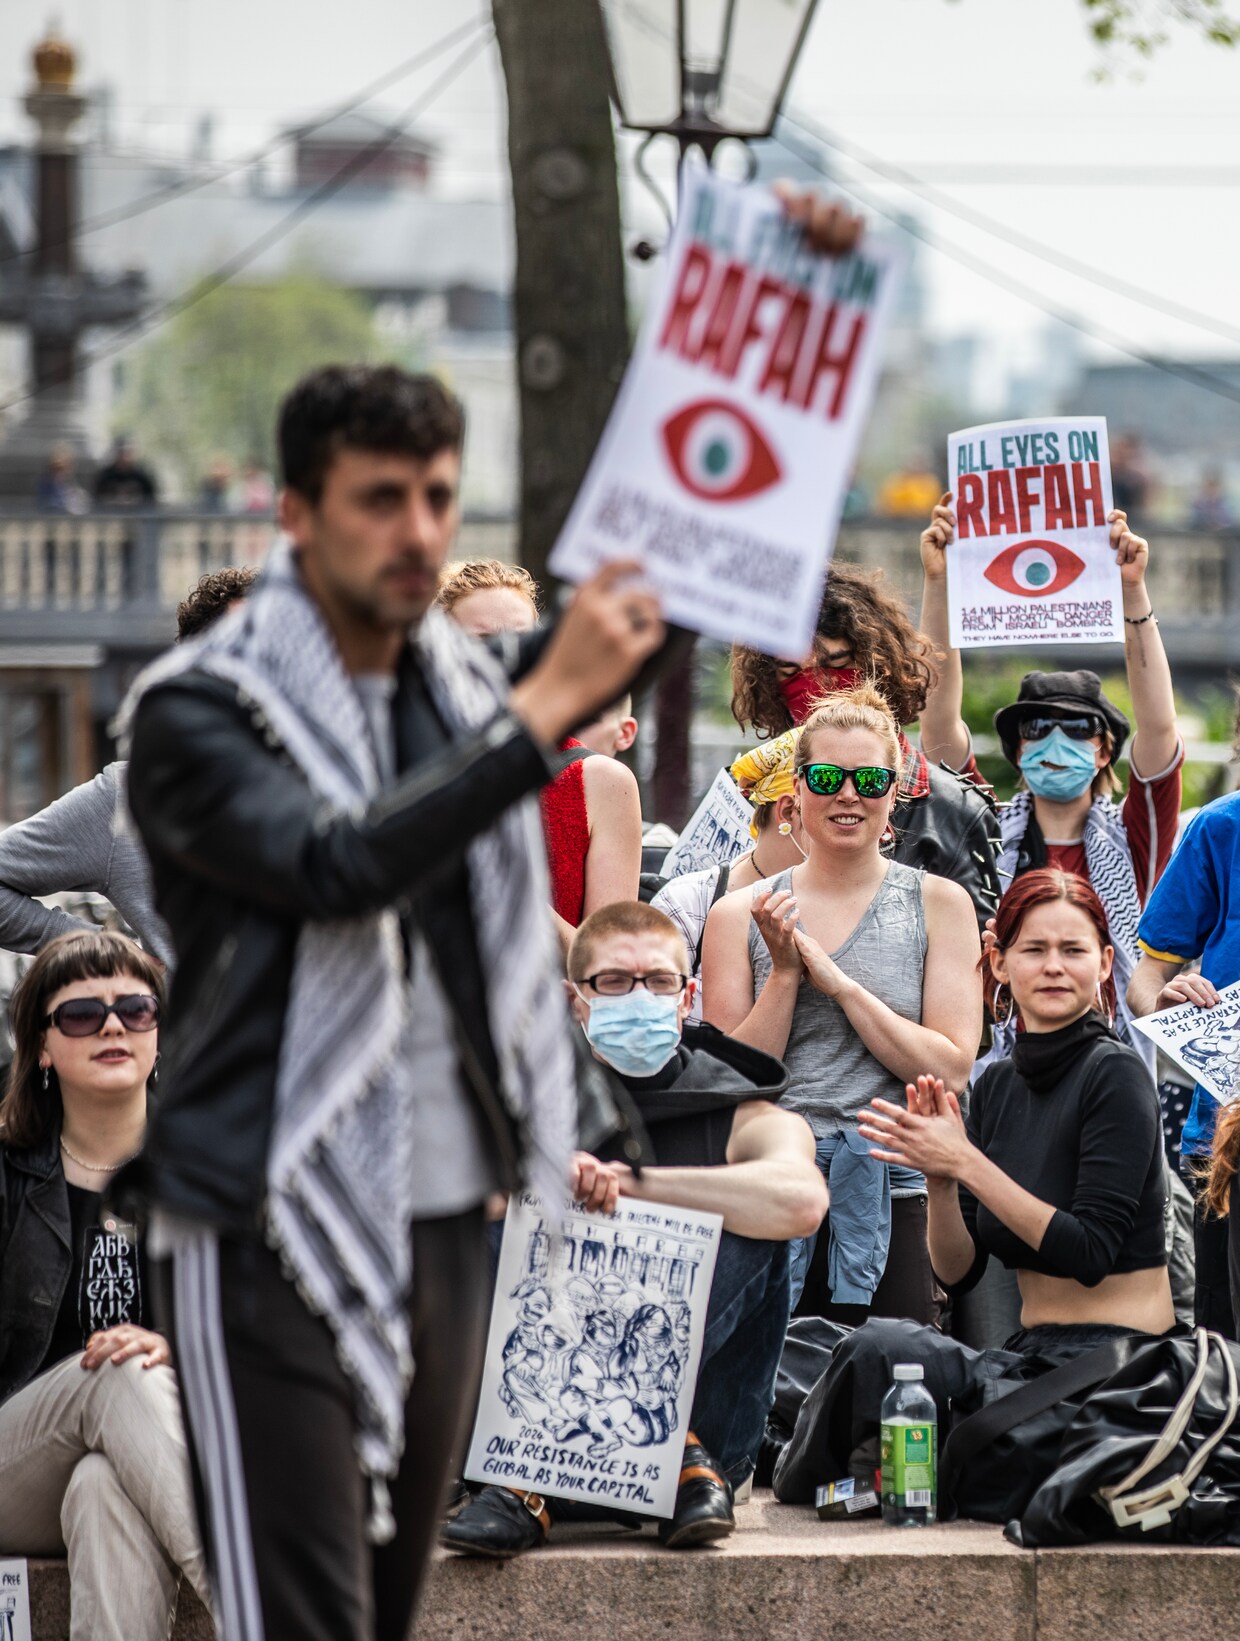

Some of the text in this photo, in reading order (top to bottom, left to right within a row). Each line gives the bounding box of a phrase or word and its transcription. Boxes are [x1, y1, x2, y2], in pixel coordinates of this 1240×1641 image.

[657, 240, 867, 424] RAFAH
[957, 431, 1099, 476] ALL EYES ON
[956, 462, 1106, 540] RAFAH
[981, 605, 1027, 616] MILLION
[1030, 600, 1112, 614] PALESTINIANS
[962, 610, 1112, 624] ARE IN MORTAL DANGER
[962, 623, 996, 632] FROM
[1005, 620, 1048, 630] ISRAELI
[1013, 632, 1059, 640] NOWHERE
[1226, 990, 1239, 1002] AS
[1151, 1005, 1203, 1025] CAPITAL
[1163, 1029, 1177, 1038] AS
[1181, 1022, 1192, 1032] IS
[683, 1223, 694, 1235] BE
[697, 1225, 714, 1240] FREE
[519, 1425, 545, 1441] 2024
[486, 1435, 661, 1481] OUR RESISTANCE IS AS
[483, 1458, 655, 1505] GLOBAL AS YOUR CAPITAL
[3, 1574, 21, 1586] FREE
